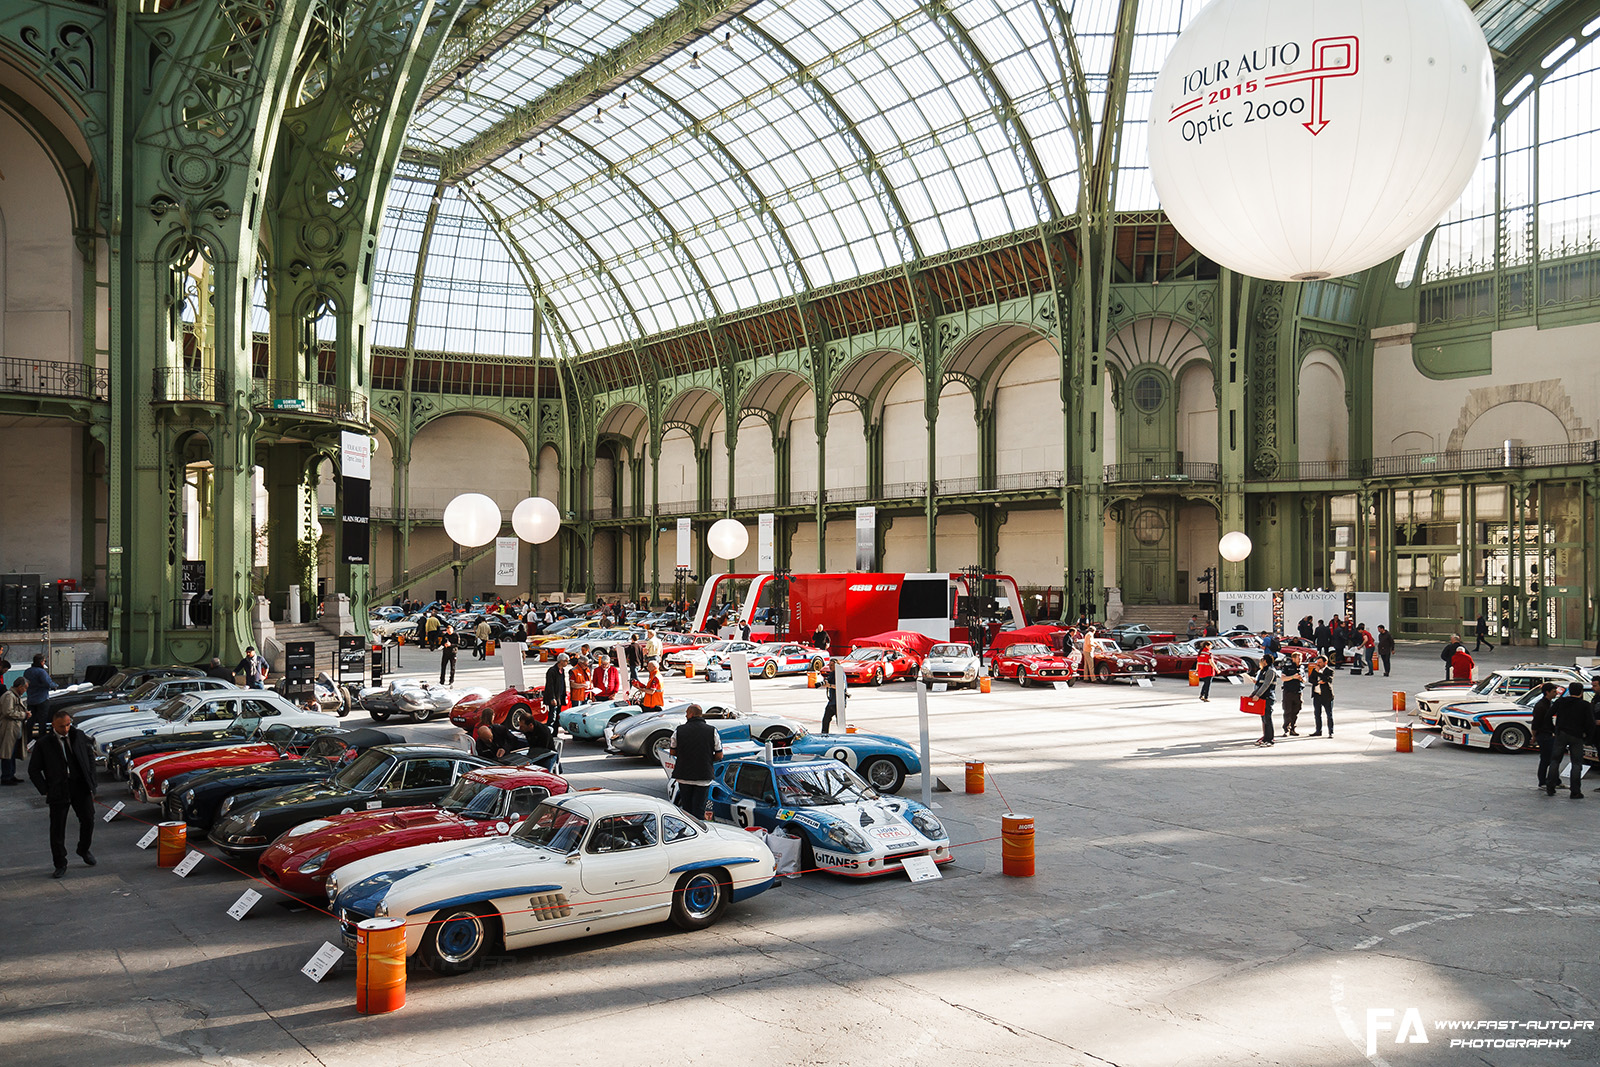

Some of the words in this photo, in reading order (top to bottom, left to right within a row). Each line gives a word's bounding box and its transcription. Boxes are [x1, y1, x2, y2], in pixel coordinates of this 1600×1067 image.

[1181, 59, 1230, 96] TOUR
[1236, 41, 1301, 77] AUTO
[1208, 79, 1258, 105] 2015
[1181, 109, 1234, 144] Optic
[1243, 97, 1306, 124] 2000
[737, 805, 749, 828] 5
[795, 814, 819, 827] MICHELIN
[876, 830, 908, 839] TOTAL
[275, 843, 296, 855] ZENITH
[815, 852, 859, 869] GITANES
